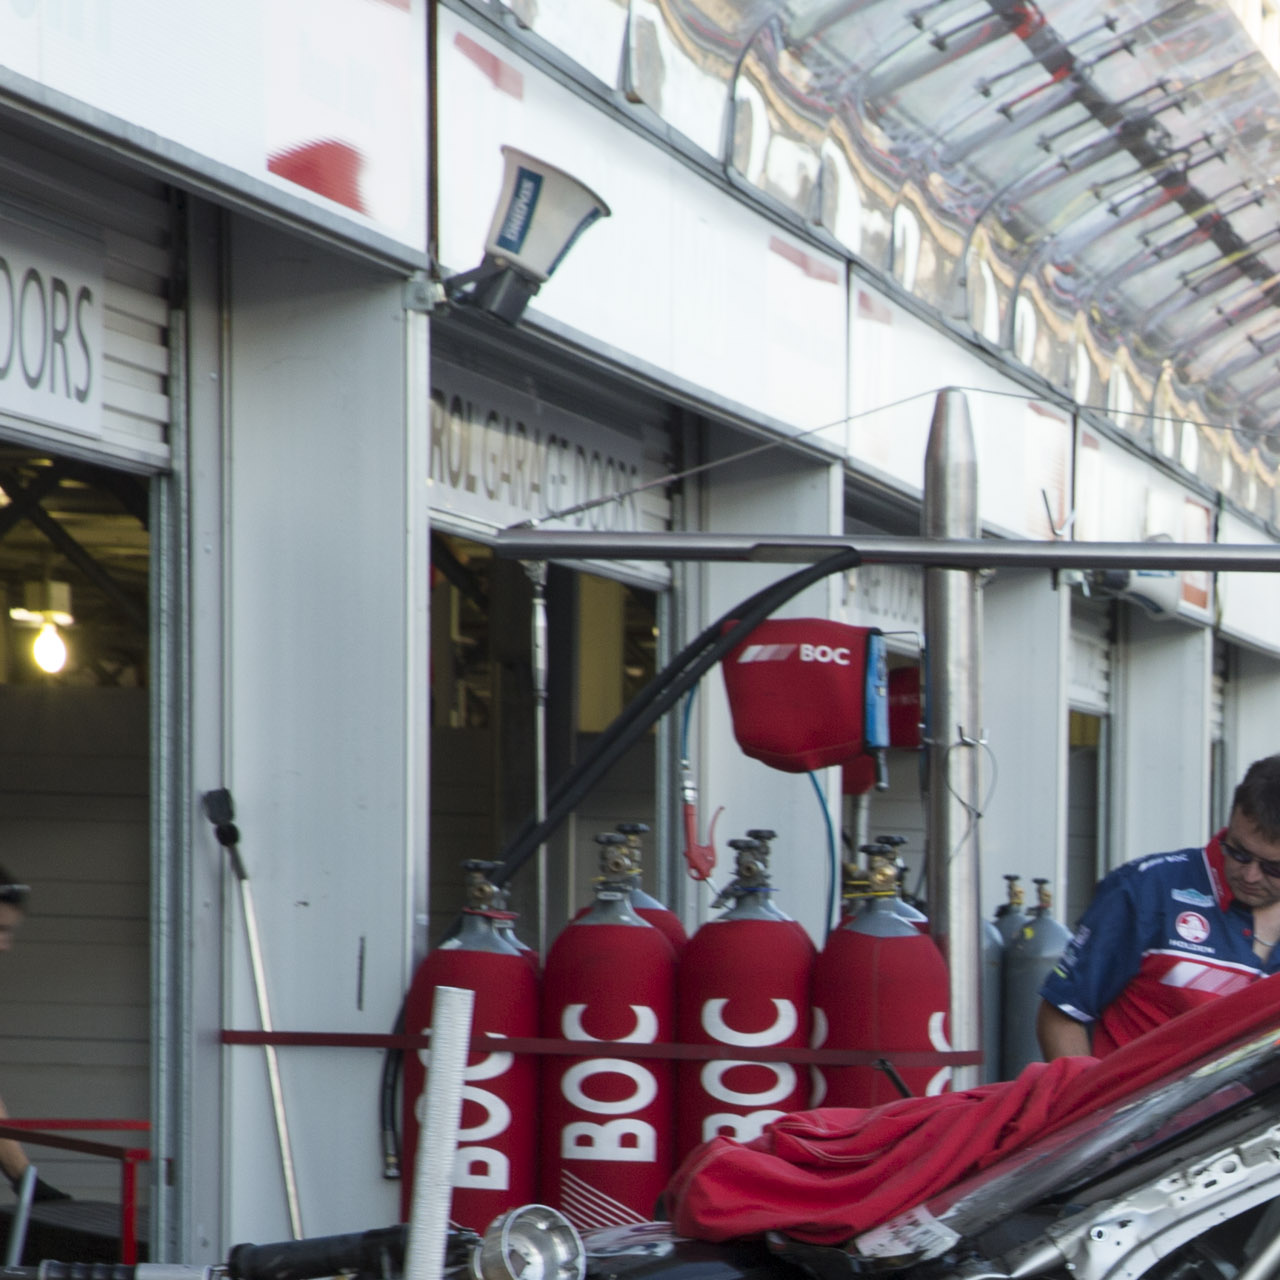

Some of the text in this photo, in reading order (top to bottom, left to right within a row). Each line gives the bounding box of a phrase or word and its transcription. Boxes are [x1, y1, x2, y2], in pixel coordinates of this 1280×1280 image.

[800, 643, 850, 666] BOC
[561, 1004, 659, 1162] BOC
[700, 998, 799, 1144] BOC
